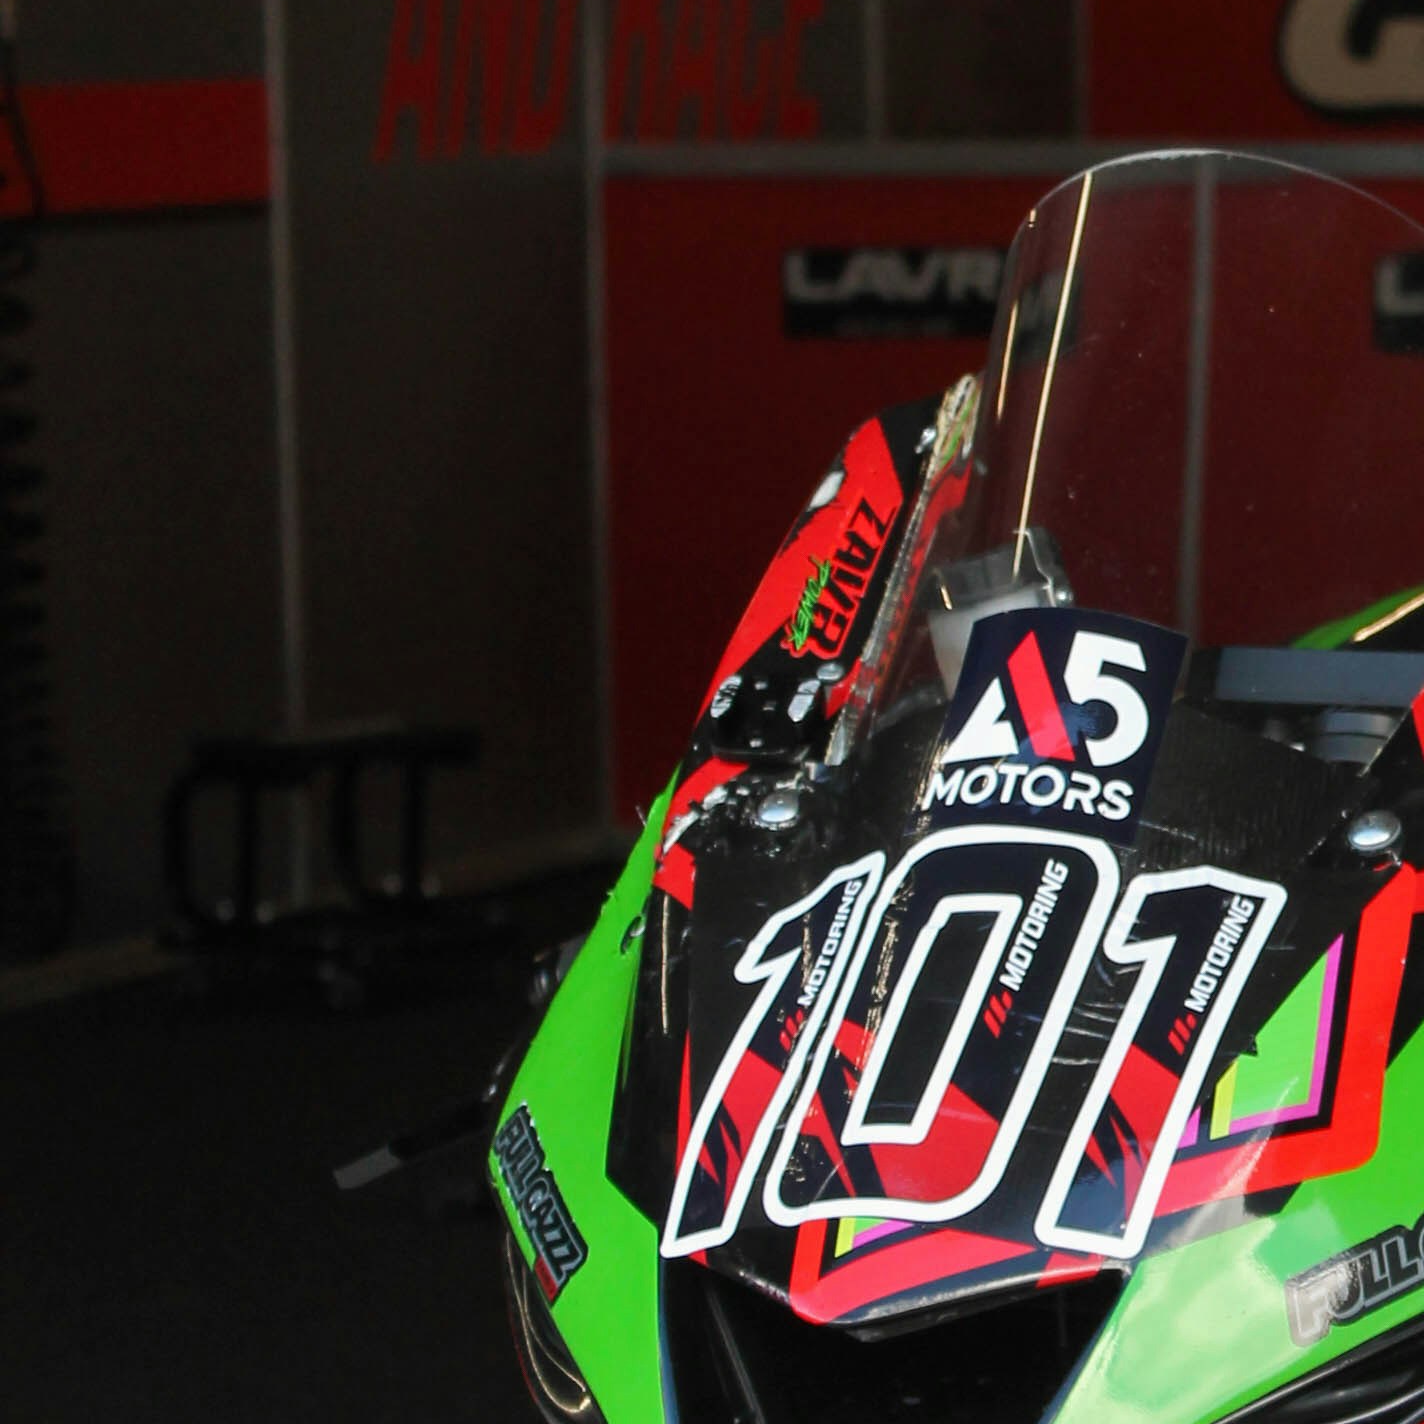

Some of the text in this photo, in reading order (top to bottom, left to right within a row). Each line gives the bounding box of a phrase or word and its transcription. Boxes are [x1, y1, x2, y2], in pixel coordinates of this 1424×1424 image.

[783, 248, 1003, 305] LAVR
[941, 628, 1150, 769] A5
[921, 760, 1134, 823] MOTORS
[798, 876, 862, 1009] MOTORING
[1007, 857, 1068, 994] MOTORING
[1183, 893, 1255, 1014] MOTORING
[660, 823, 1288, 1259] 101
